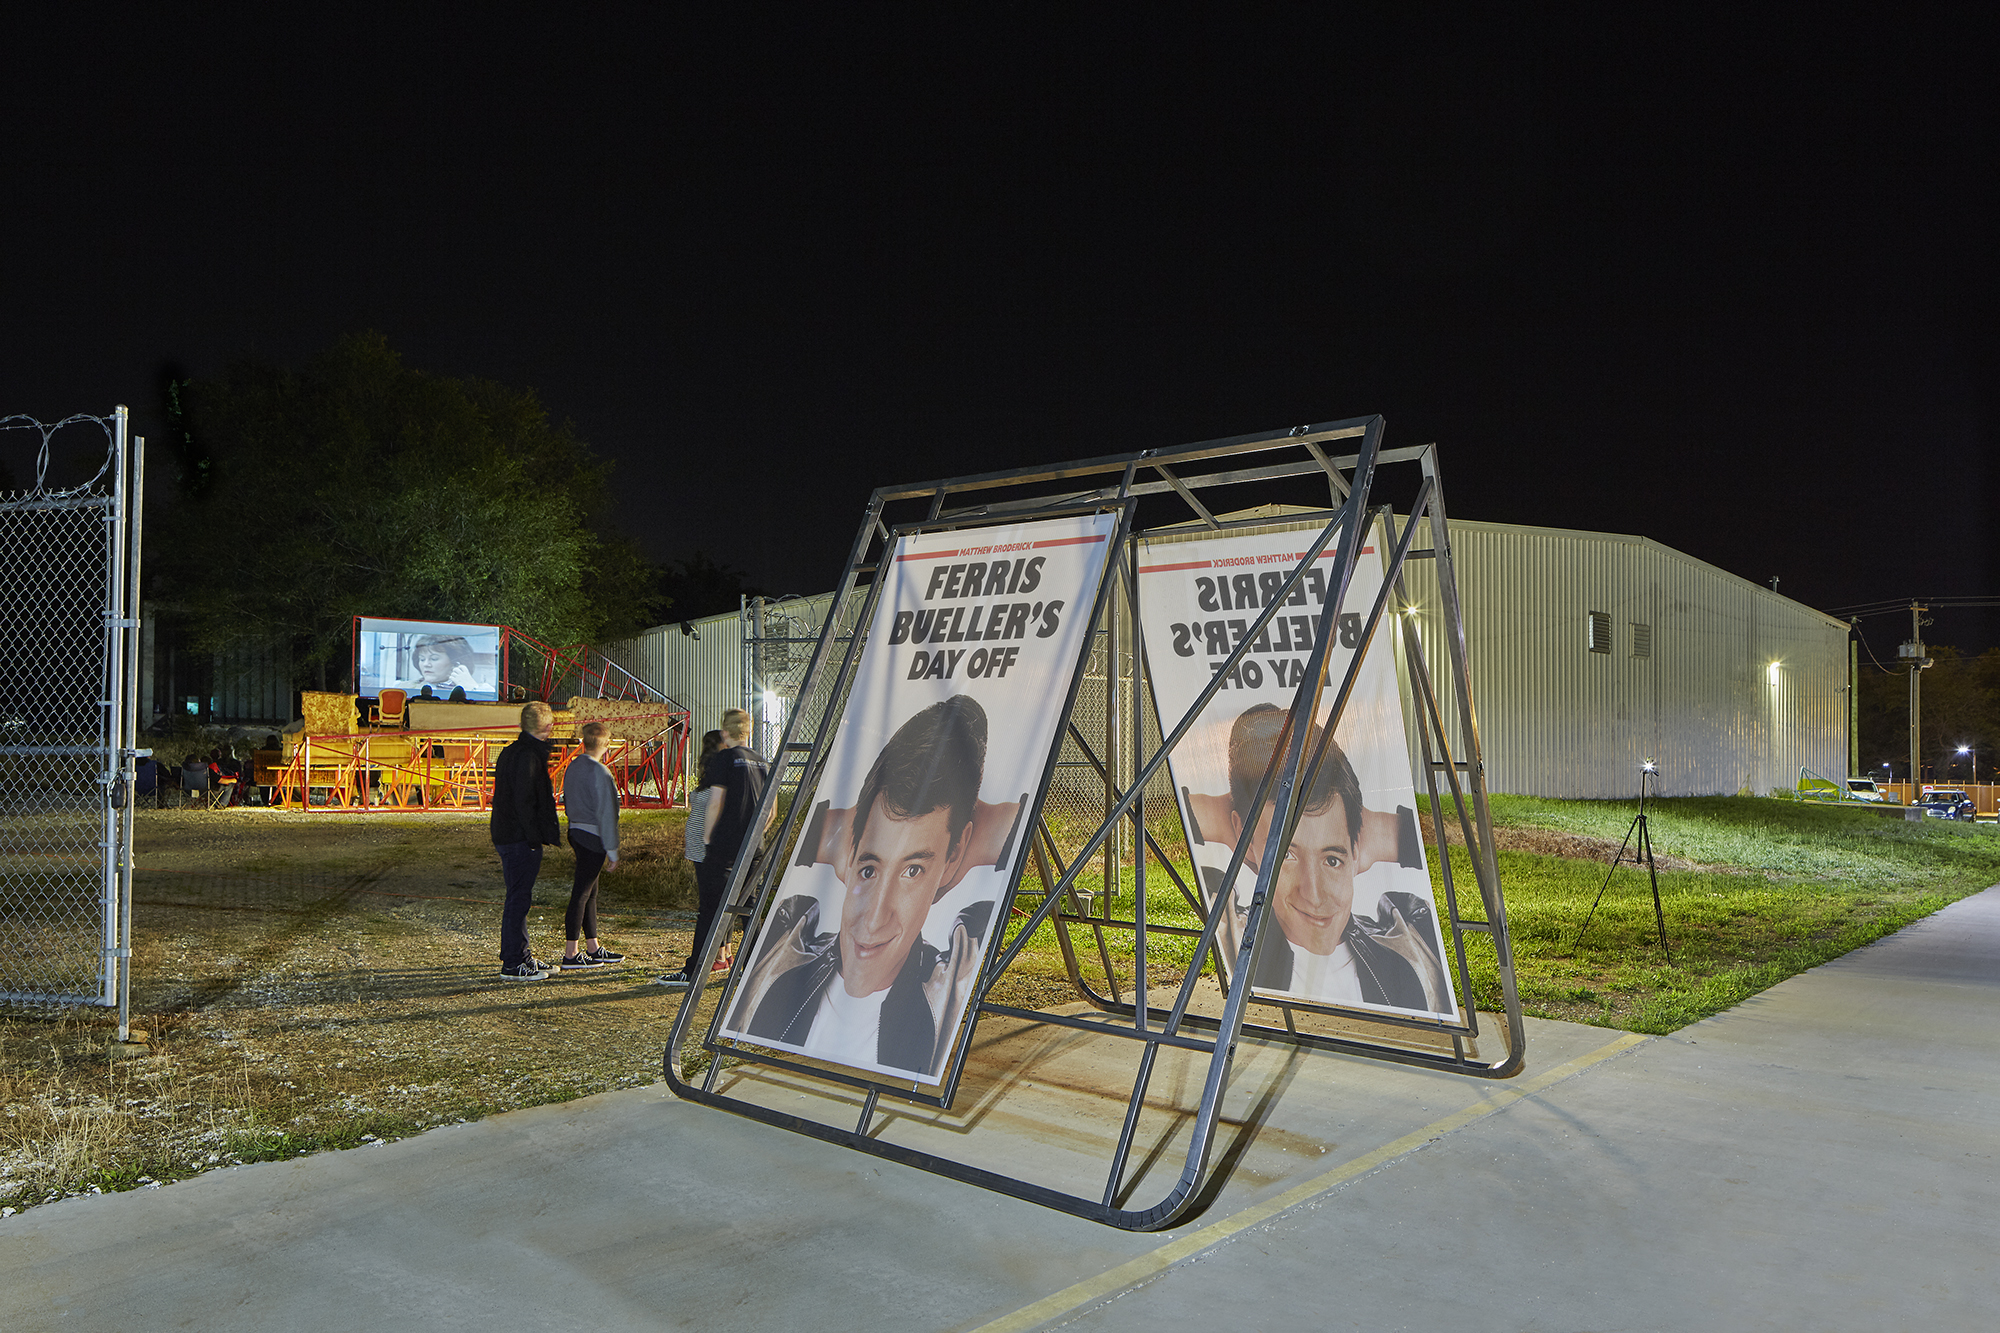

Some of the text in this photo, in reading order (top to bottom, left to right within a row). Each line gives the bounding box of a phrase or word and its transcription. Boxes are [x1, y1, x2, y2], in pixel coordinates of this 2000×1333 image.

[959, 541, 1032, 557] MATTHEW BRODERICK
[924, 556, 1046, 600] FERRIS
[888, 600, 1065, 645] BUELLER'S
[907, 647, 1020, 680] DAY OFF
